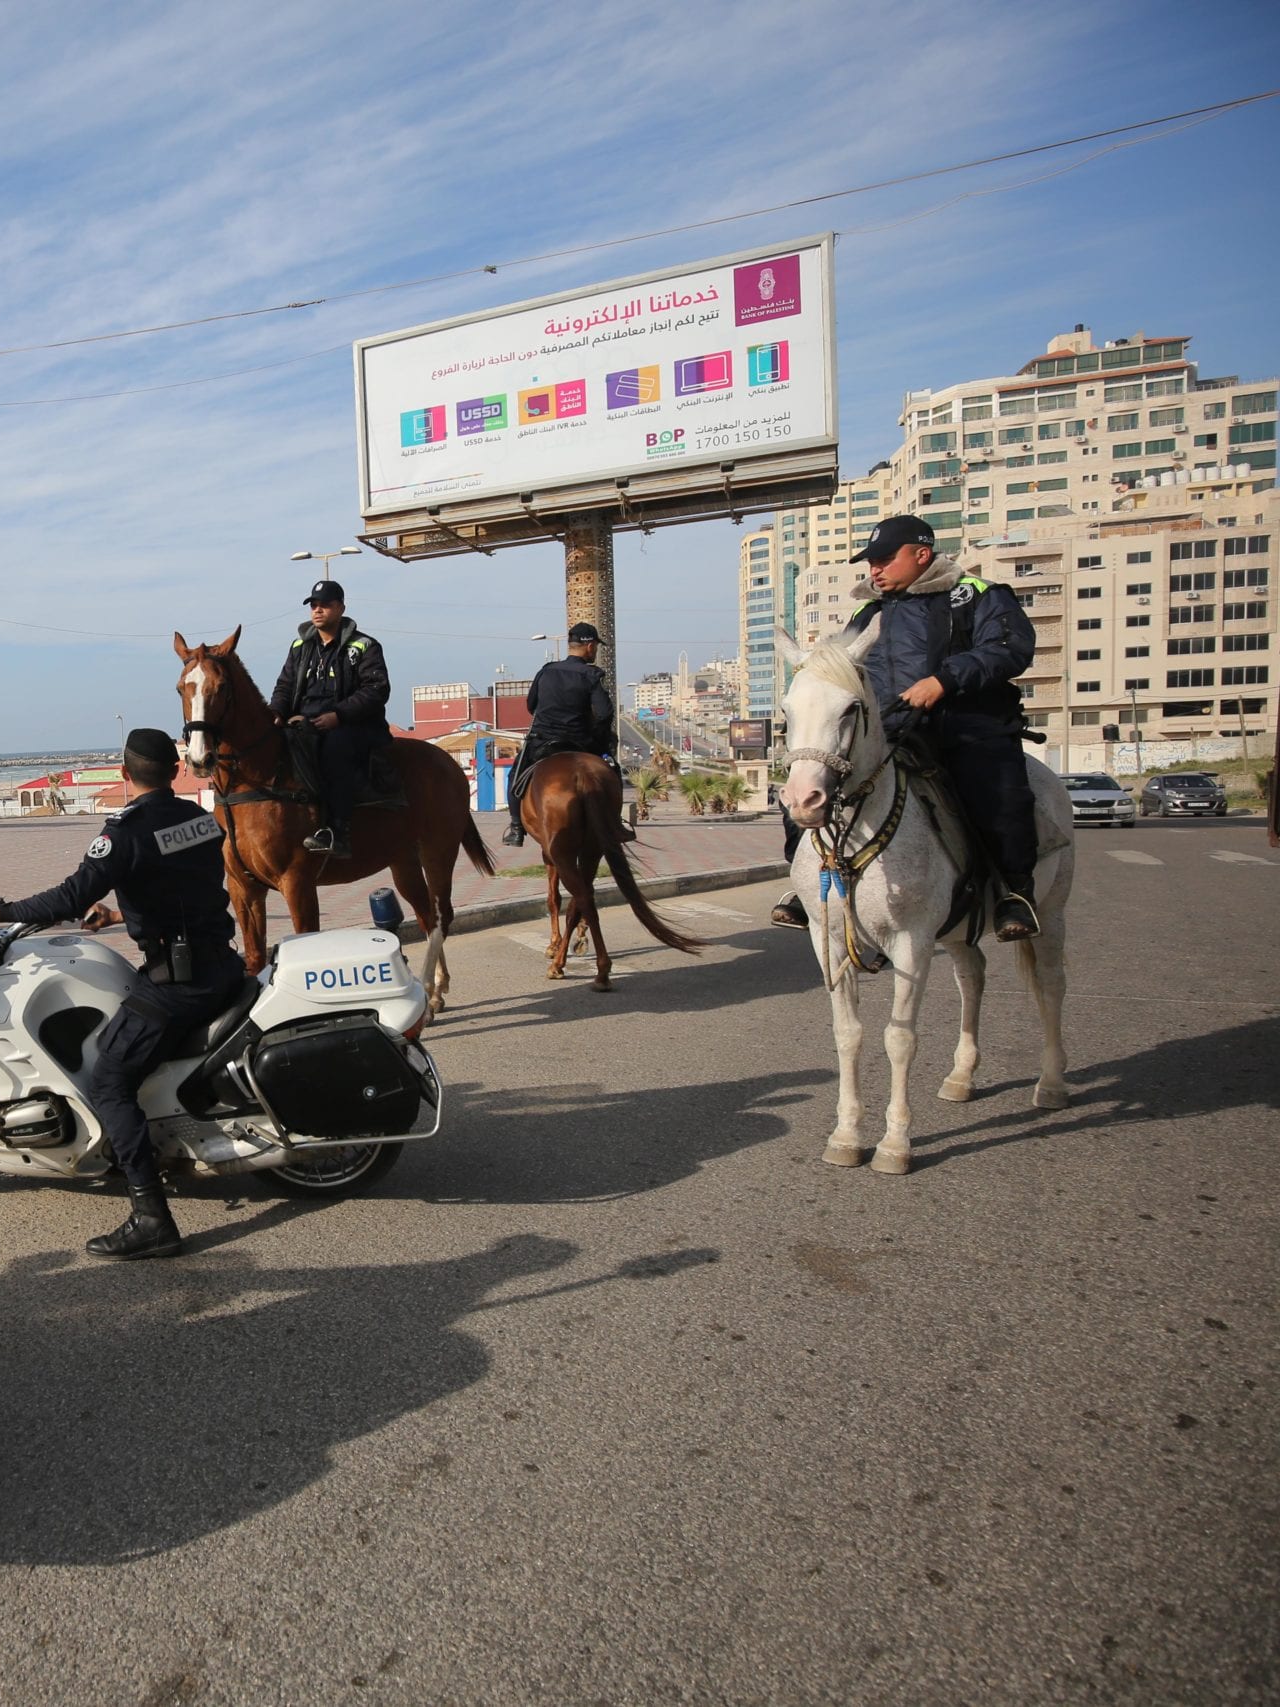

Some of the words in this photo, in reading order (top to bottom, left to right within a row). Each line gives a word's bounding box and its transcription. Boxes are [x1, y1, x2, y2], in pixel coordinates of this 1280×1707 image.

[649, 284, 719, 313] خدماتنا
[544, 299, 641, 338] الإلكترونية
[698, 309, 720, 326] تتيح
[741, 312, 756, 320] BANK
[766, 305, 795, 315] PALESTINE
[649, 318, 671, 334] إنجاز
[674, 314, 695, 331] لكم
[591, 327, 646, 347] معاملاتكم
[540, 336, 589, 356] المصرفية
[462, 357, 485, 371] لزيارة
[488, 352, 515, 366] الحاجة
[518, 350, 538, 361] دون
[431, 363, 460, 380] الفروع
[461, 404, 501, 422] USSD
[760, 411, 791, 425] للمزيد
[557, 422, 569, 430] IVR
[695, 420, 740, 435] المعلومات
[743, 419, 758, 429] من
[463, 437, 483, 446] USSD
[696, 434, 730, 450] 1700
[735, 429, 760, 443] 150
[766, 424, 791, 438] 150
[161, 818, 218, 849] POLICE
[305, 962, 393, 990] POLICE
